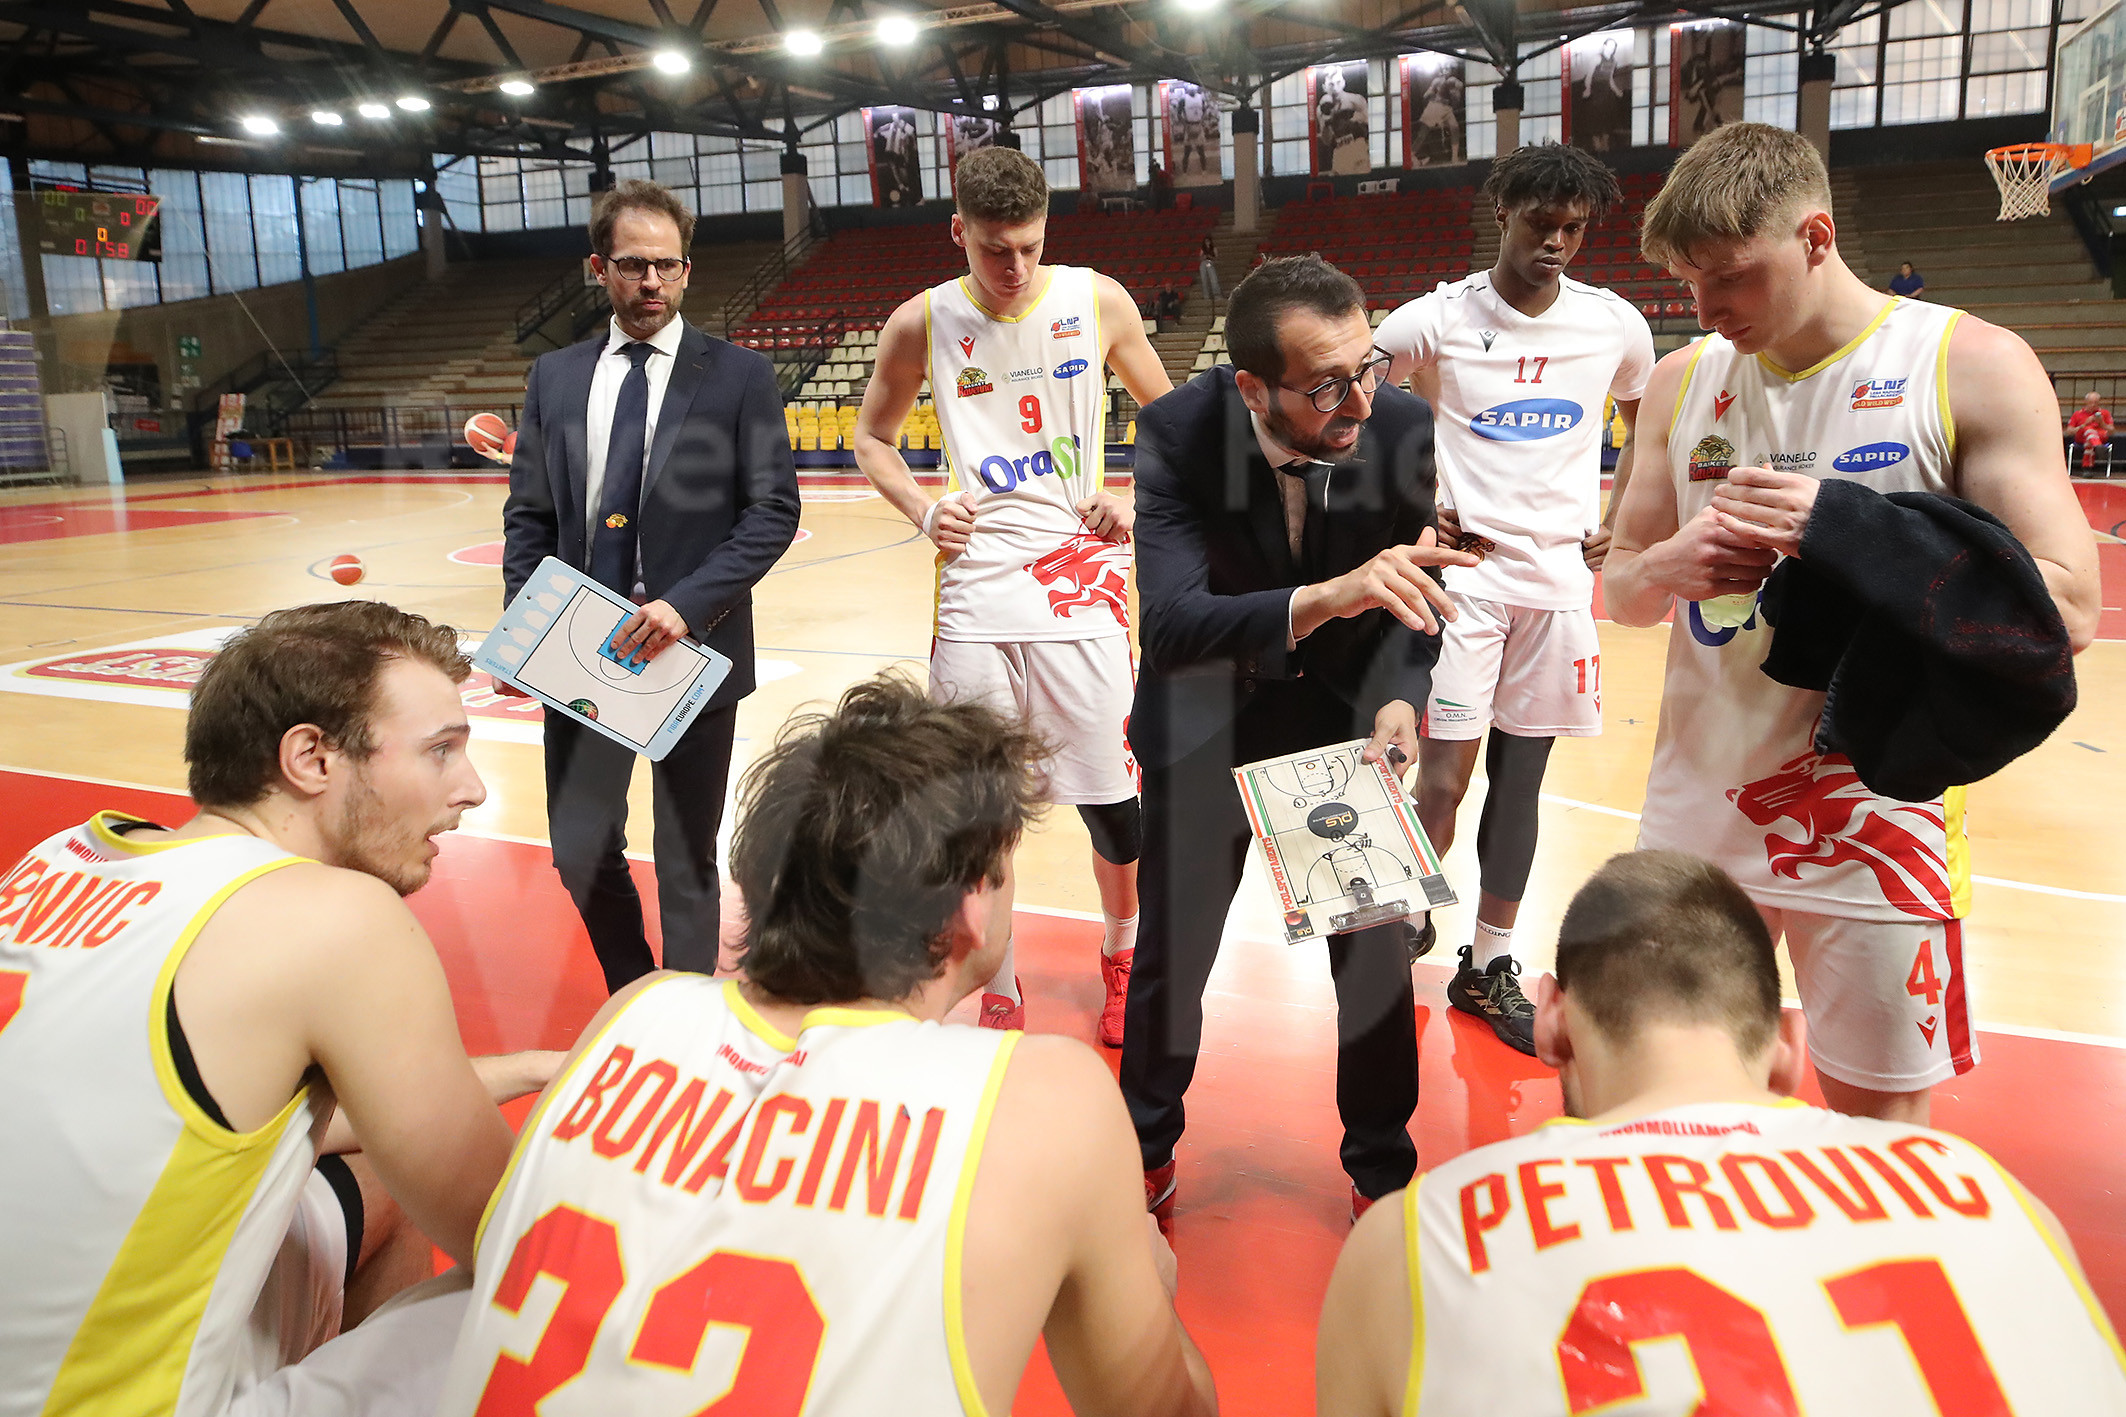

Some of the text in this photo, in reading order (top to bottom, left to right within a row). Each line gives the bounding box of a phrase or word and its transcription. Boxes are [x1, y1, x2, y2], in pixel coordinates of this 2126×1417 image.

[1010, 367, 1043, 377] VIANELLO
[1055, 364, 1086, 375] SAPIR
[1513, 356, 1549, 384] 17
[1018, 394, 1043, 435] 9
[1480, 411, 1573, 429] SAPIR
[1839, 451, 1902, 463] SAPIR
[1905, 939, 1943, 1006] 4
[550, 1044, 946, 1223] BONACINI
[1458, 1135, 1992, 1275] PETROVIC
